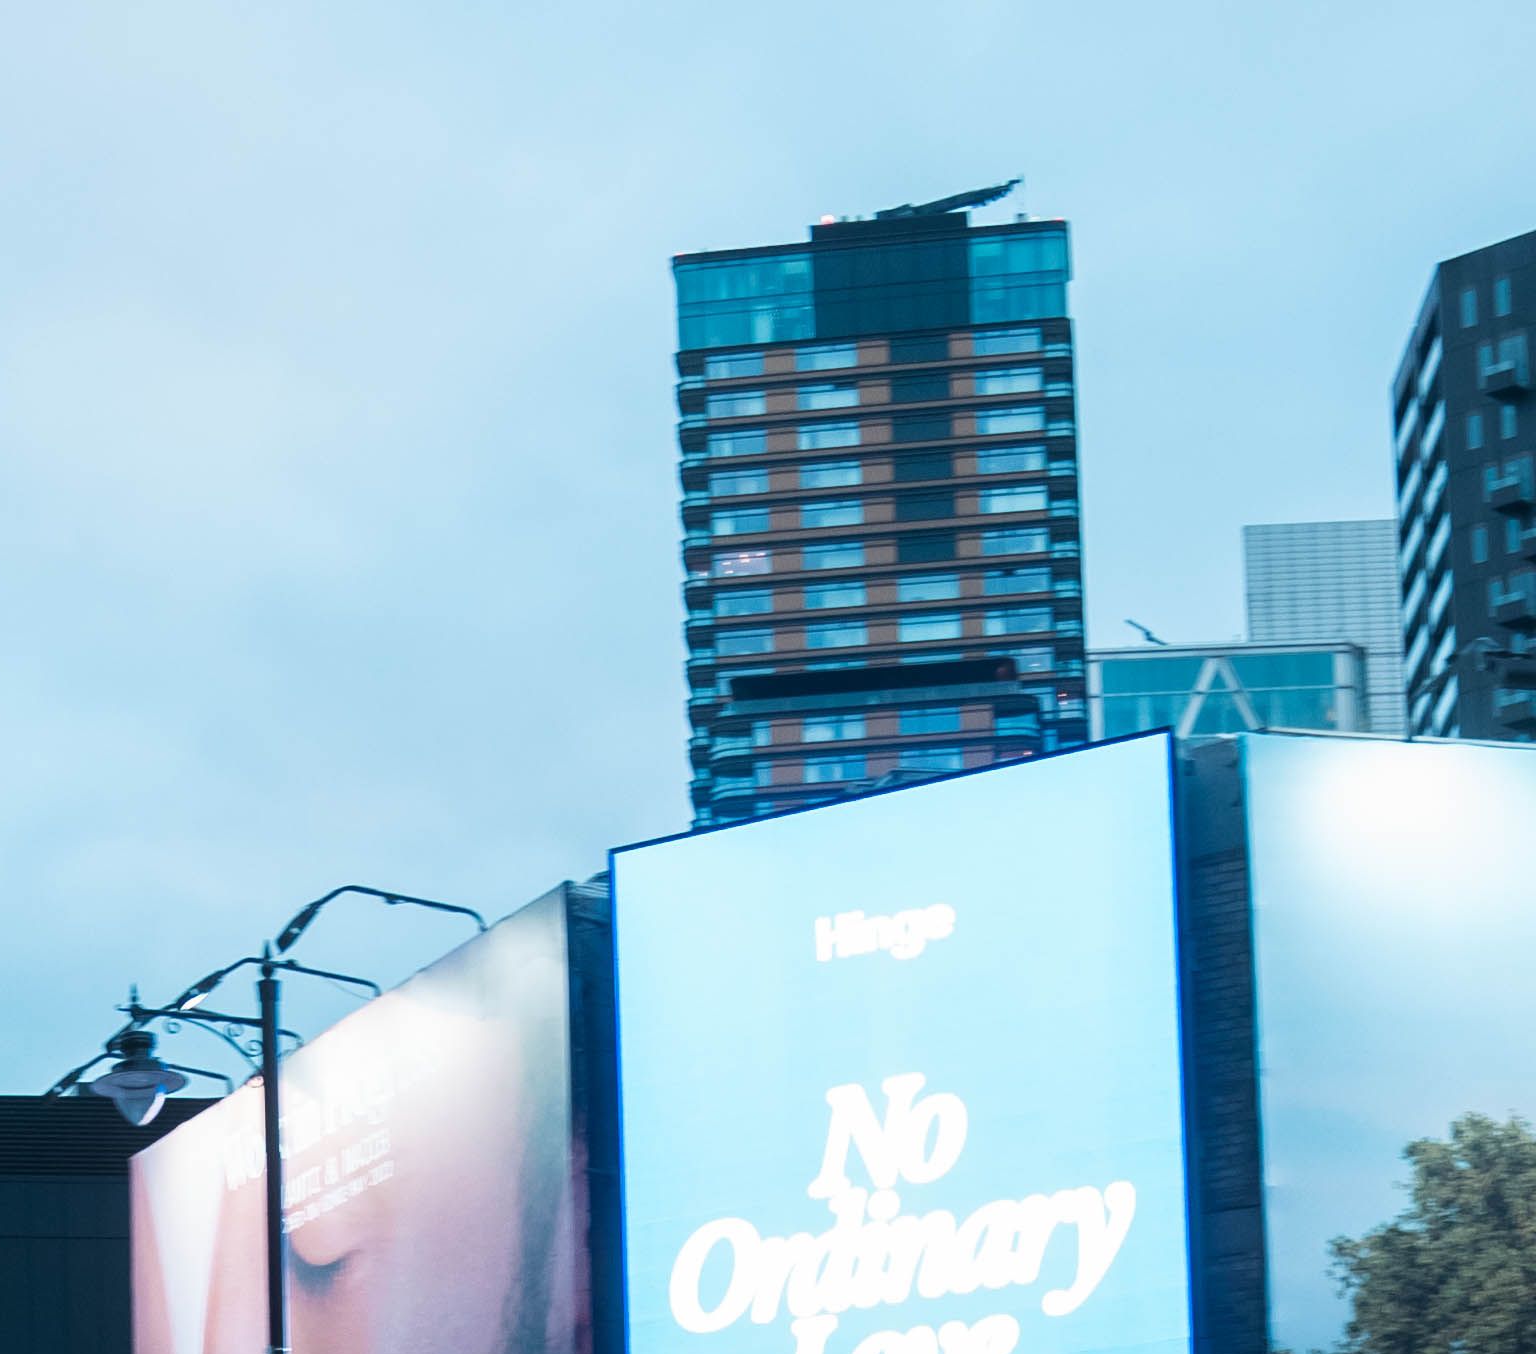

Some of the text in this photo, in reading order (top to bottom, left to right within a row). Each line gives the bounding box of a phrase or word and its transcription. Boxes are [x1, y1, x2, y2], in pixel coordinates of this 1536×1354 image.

[815, 904, 955, 961] Hinge
[808, 1072, 967, 1199] No
[670, 1181, 1135, 1333] Ordinary
